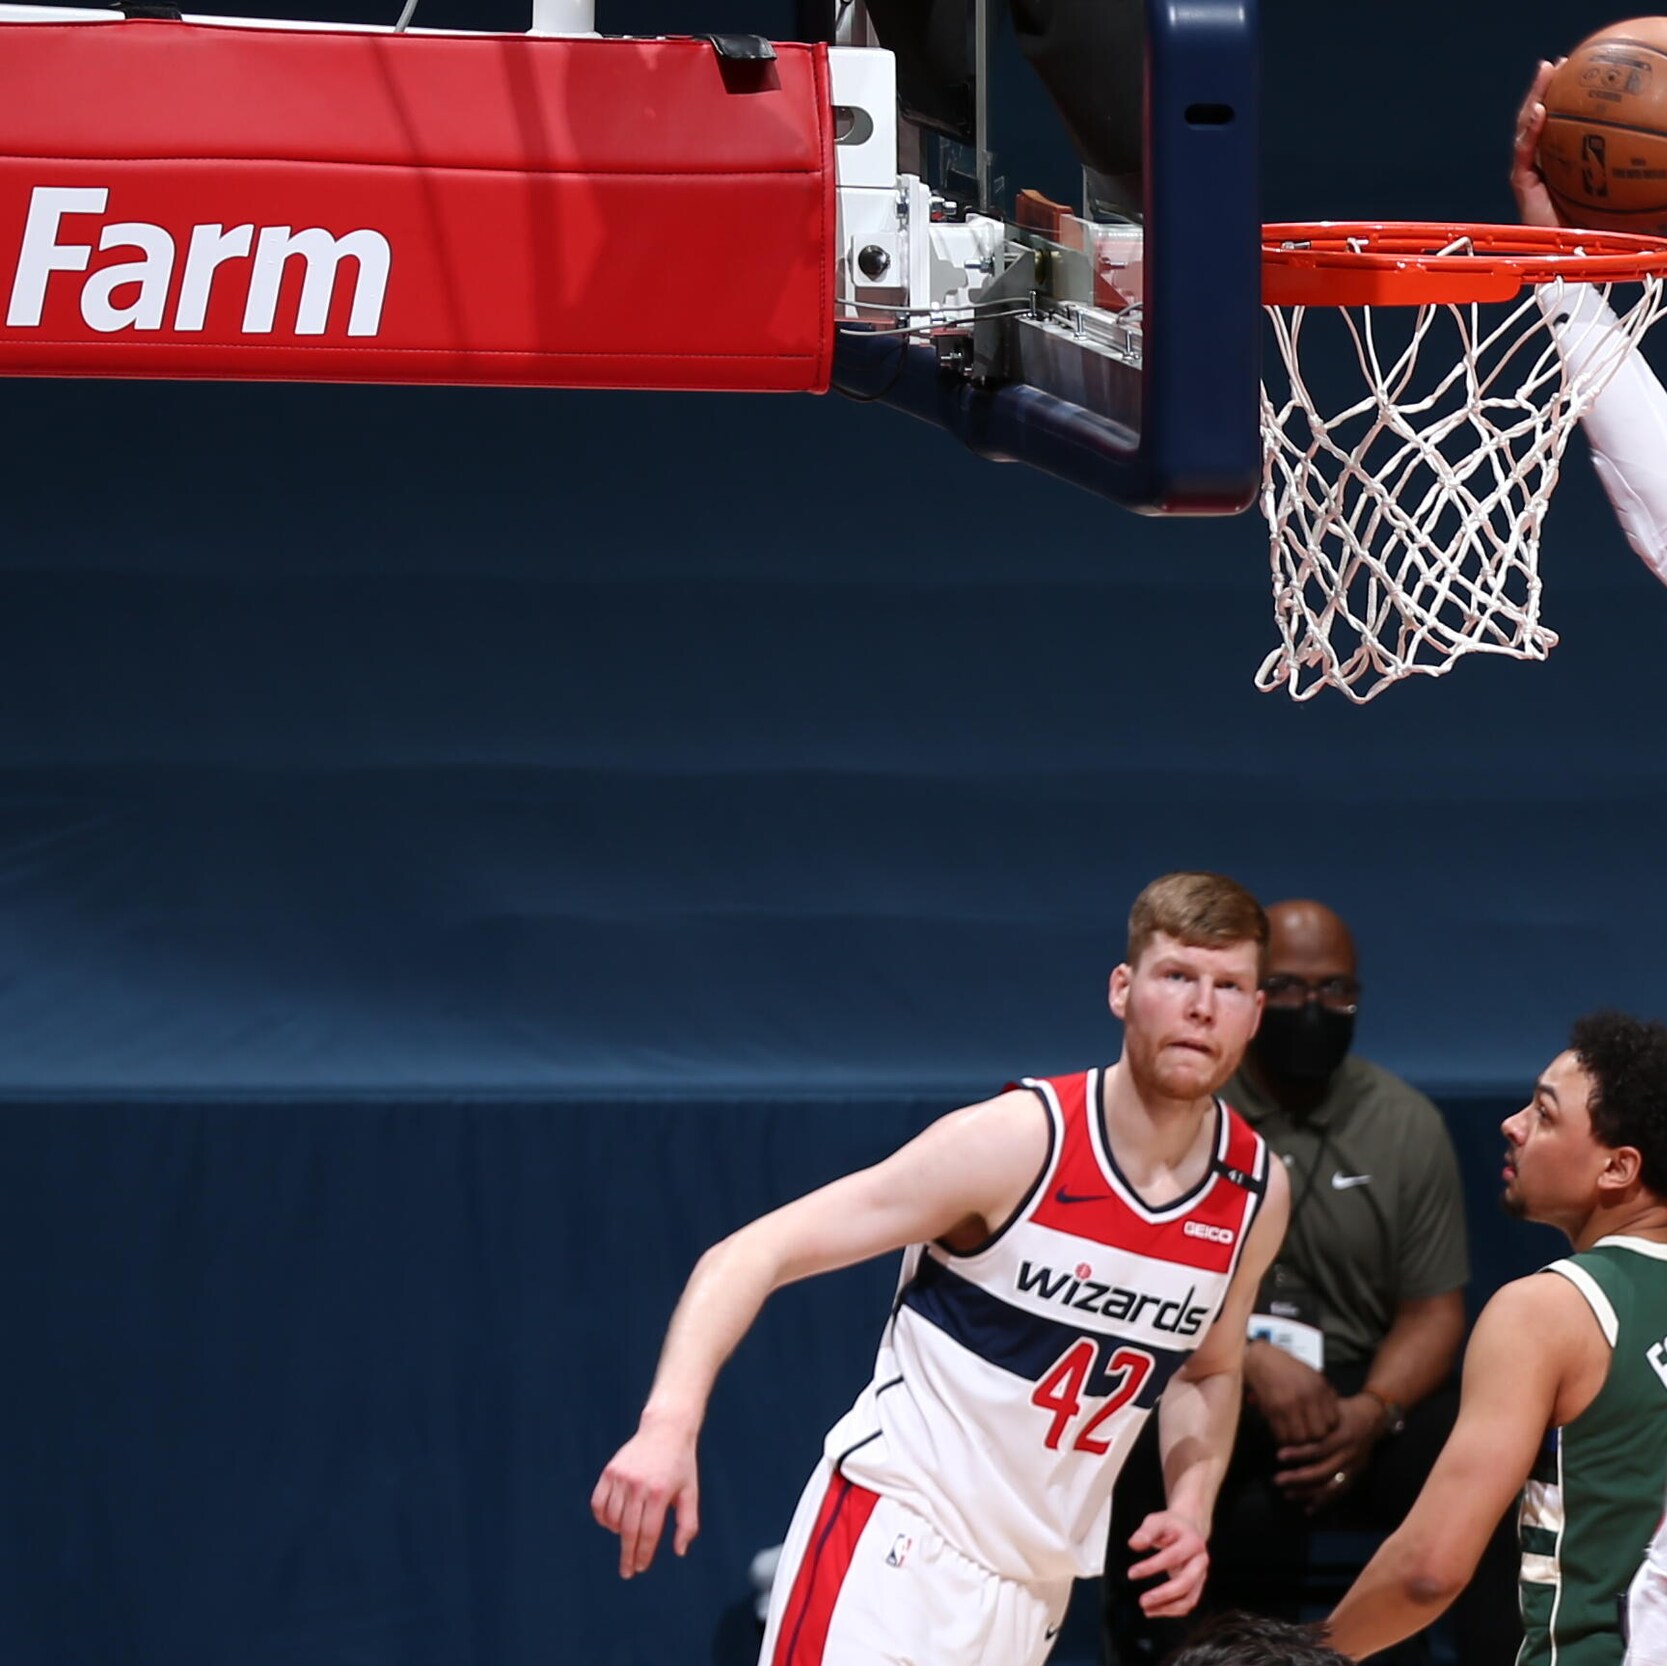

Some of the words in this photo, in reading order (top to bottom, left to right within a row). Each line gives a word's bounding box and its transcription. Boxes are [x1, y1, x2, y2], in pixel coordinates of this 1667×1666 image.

[6, 187, 391, 337] Farm
[1183, 1220, 1235, 1245] GEICO
[1030, 1337, 1156, 1455] 42
